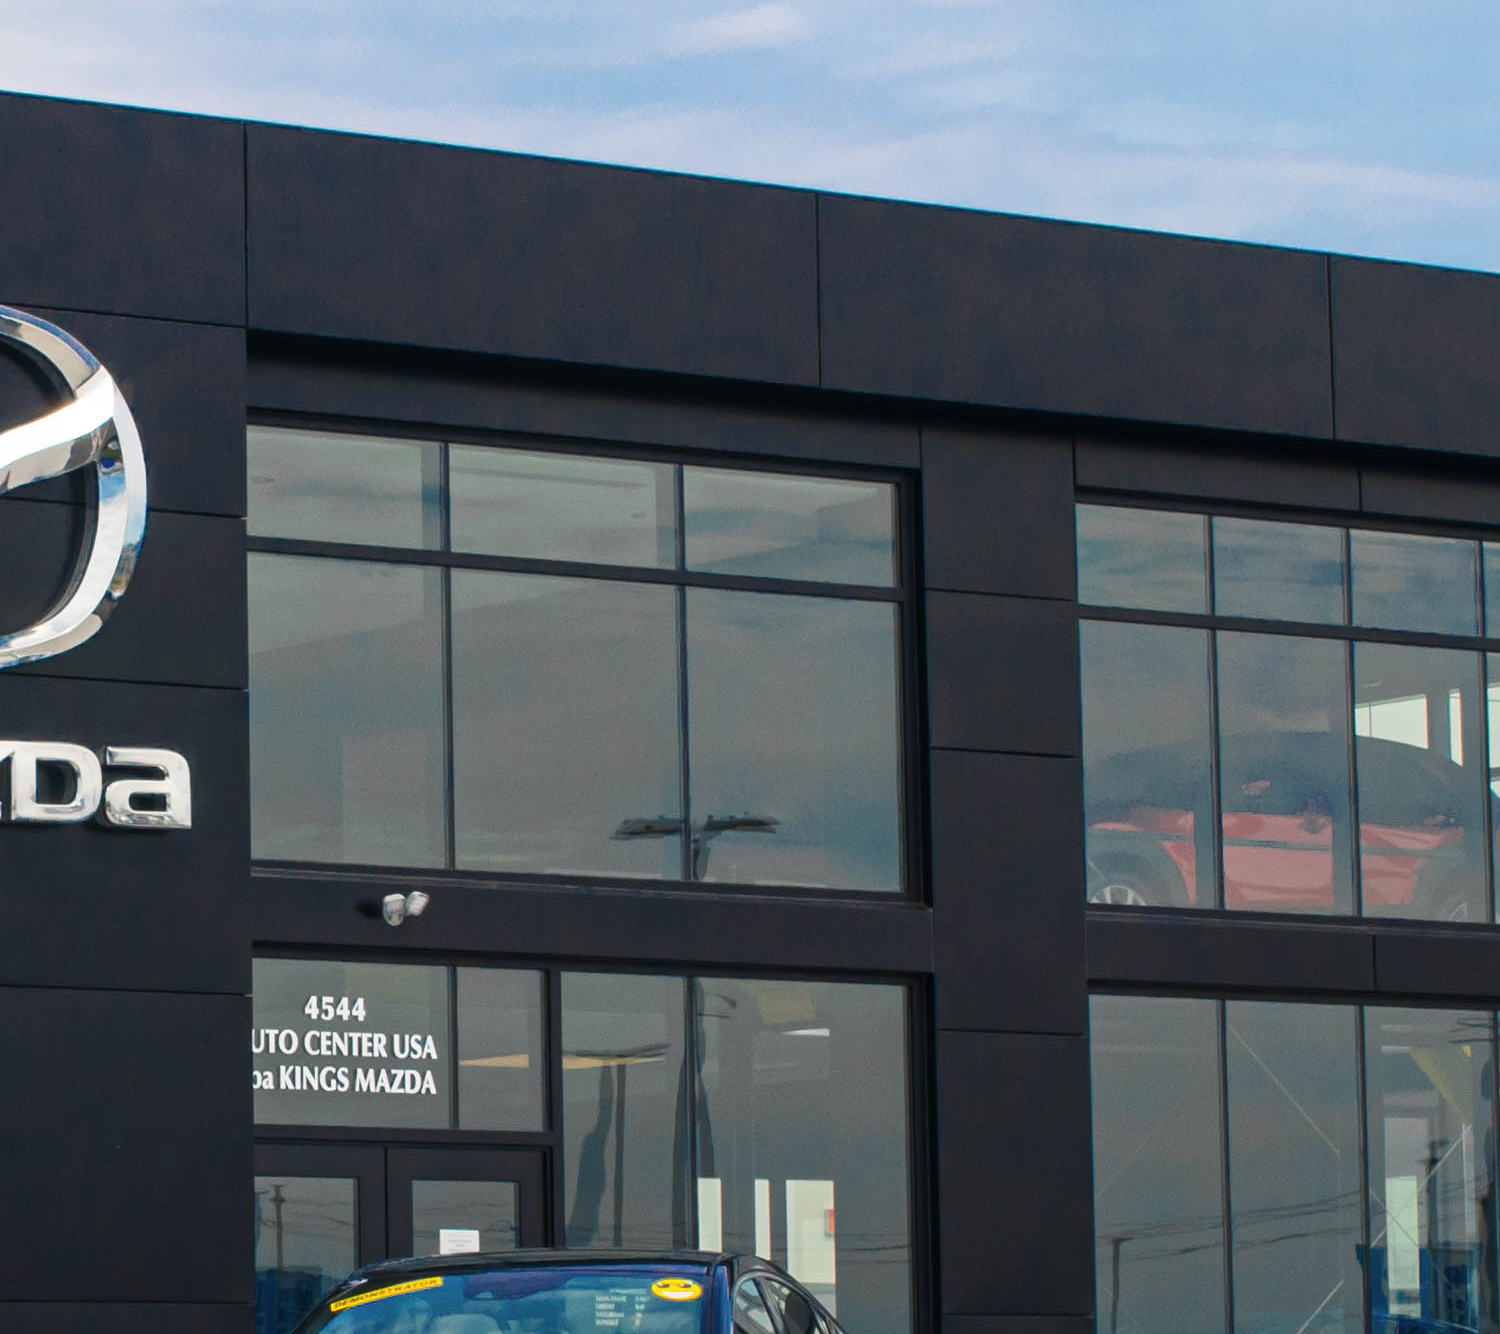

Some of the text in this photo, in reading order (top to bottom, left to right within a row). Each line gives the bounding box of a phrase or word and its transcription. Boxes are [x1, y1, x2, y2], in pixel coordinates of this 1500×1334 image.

[304, 995, 367, 1022] 4544
[304, 1030, 388, 1058] CENTER
[393, 1033, 438, 1060] USA
[279, 1065, 350, 1093] KINGS
[354, 1068, 437, 1095] MAZDA
[334, 1279, 438, 1309] DEMONSTRATOR
